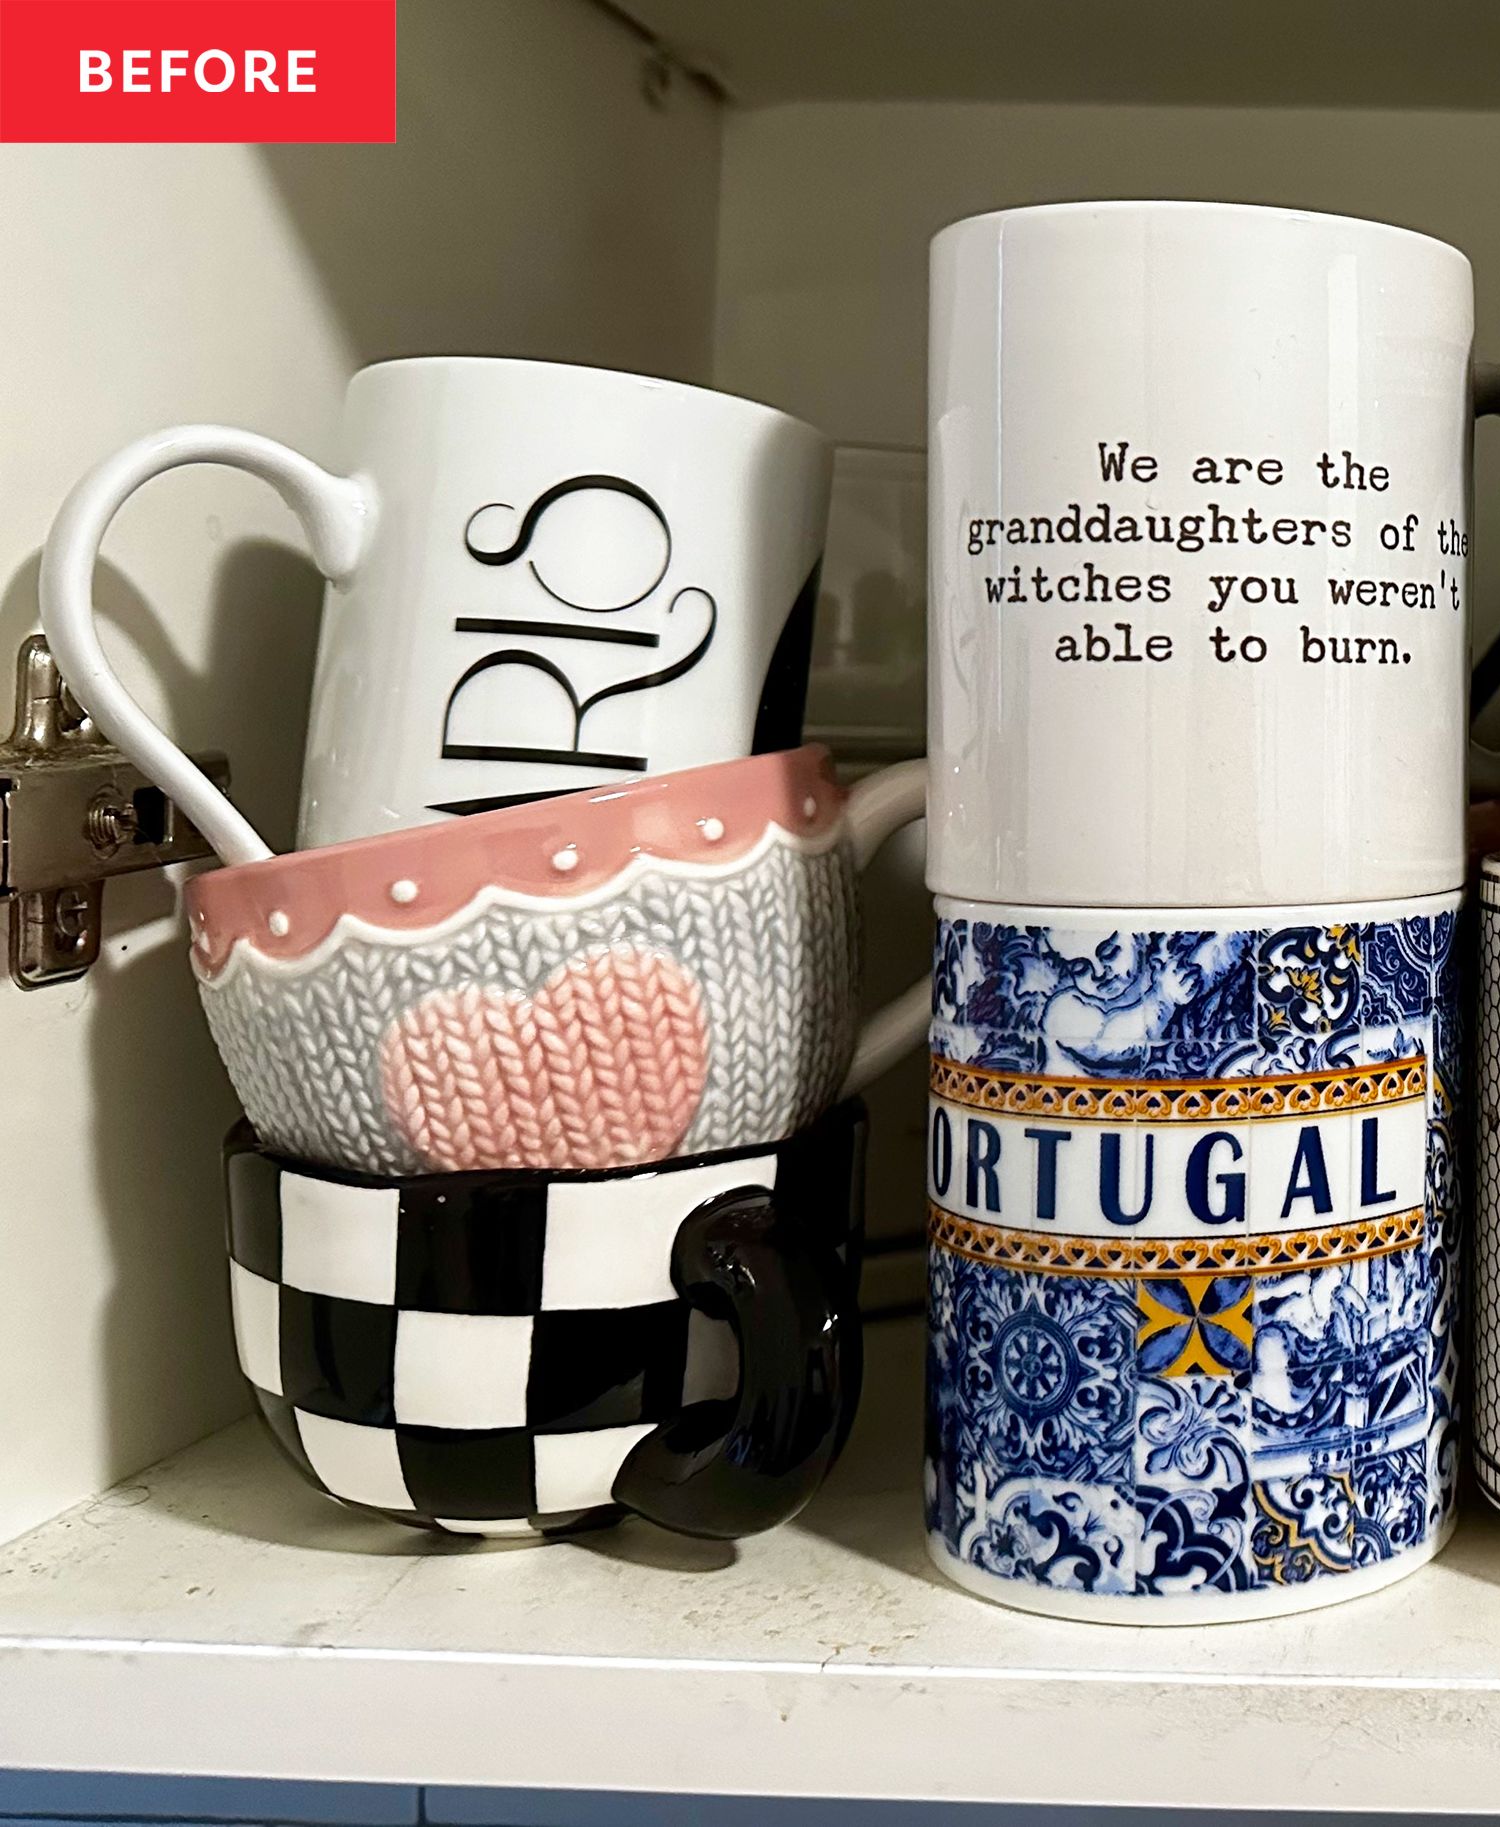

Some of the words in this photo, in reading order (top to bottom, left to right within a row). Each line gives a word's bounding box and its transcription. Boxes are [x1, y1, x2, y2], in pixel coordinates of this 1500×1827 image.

[1099, 441, 1158, 483] We
[1192, 457, 1284, 486] are
[1316, 450, 1390, 492] the
[967, 502, 1352, 555] granddaughters
[1380, 514, 1419, 552] of
[1437, 518, 1469, 558] the
[984, 562, 1172, 604] witches
[1207, 575, 1299, 613] you
[1327, 569, 1460, 611] weren't
[1055, 623, 1173, 663] able
[1209, 626, 1267, 663] to
[1300, 626, 1411, 665] burn.
